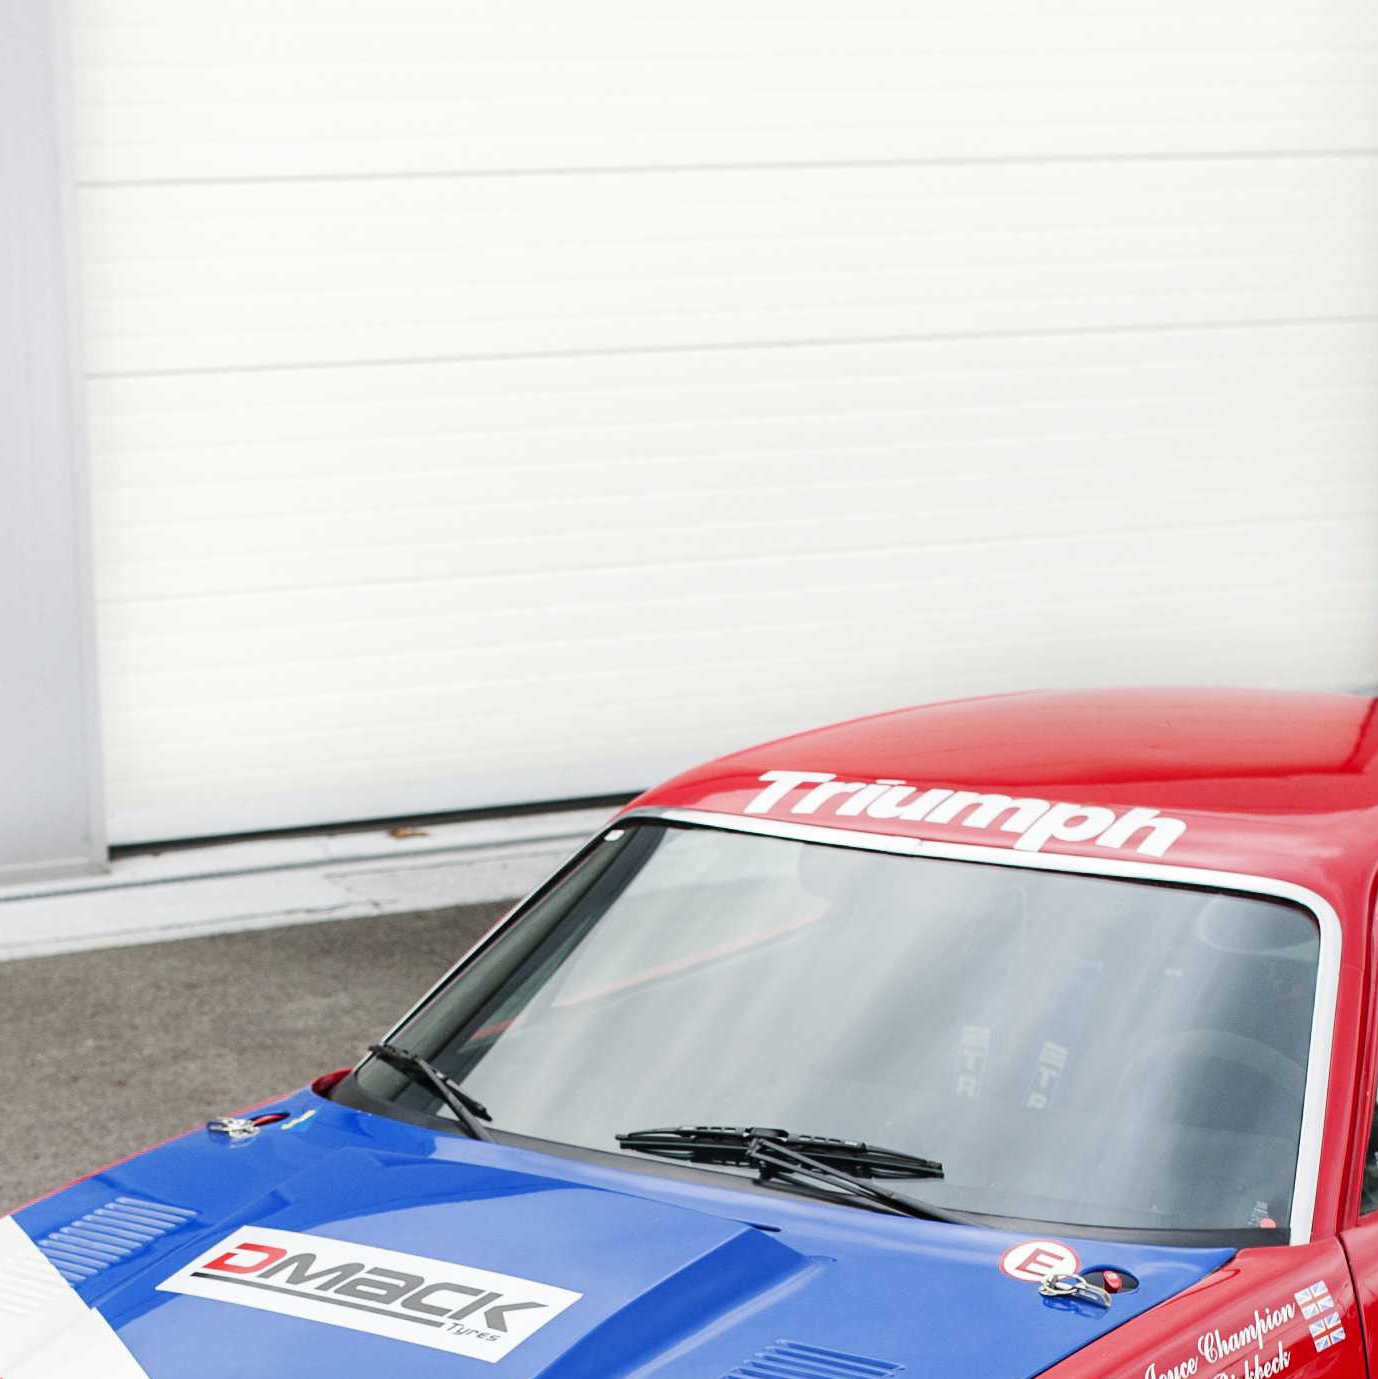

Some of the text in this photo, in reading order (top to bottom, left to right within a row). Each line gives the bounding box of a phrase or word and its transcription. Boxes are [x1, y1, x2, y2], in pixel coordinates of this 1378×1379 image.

[743, 770, 1187, 858] Triumph
[1015, 1246, 1065, 1277] E
[1197, 1302, 1296, 1364] Champion
